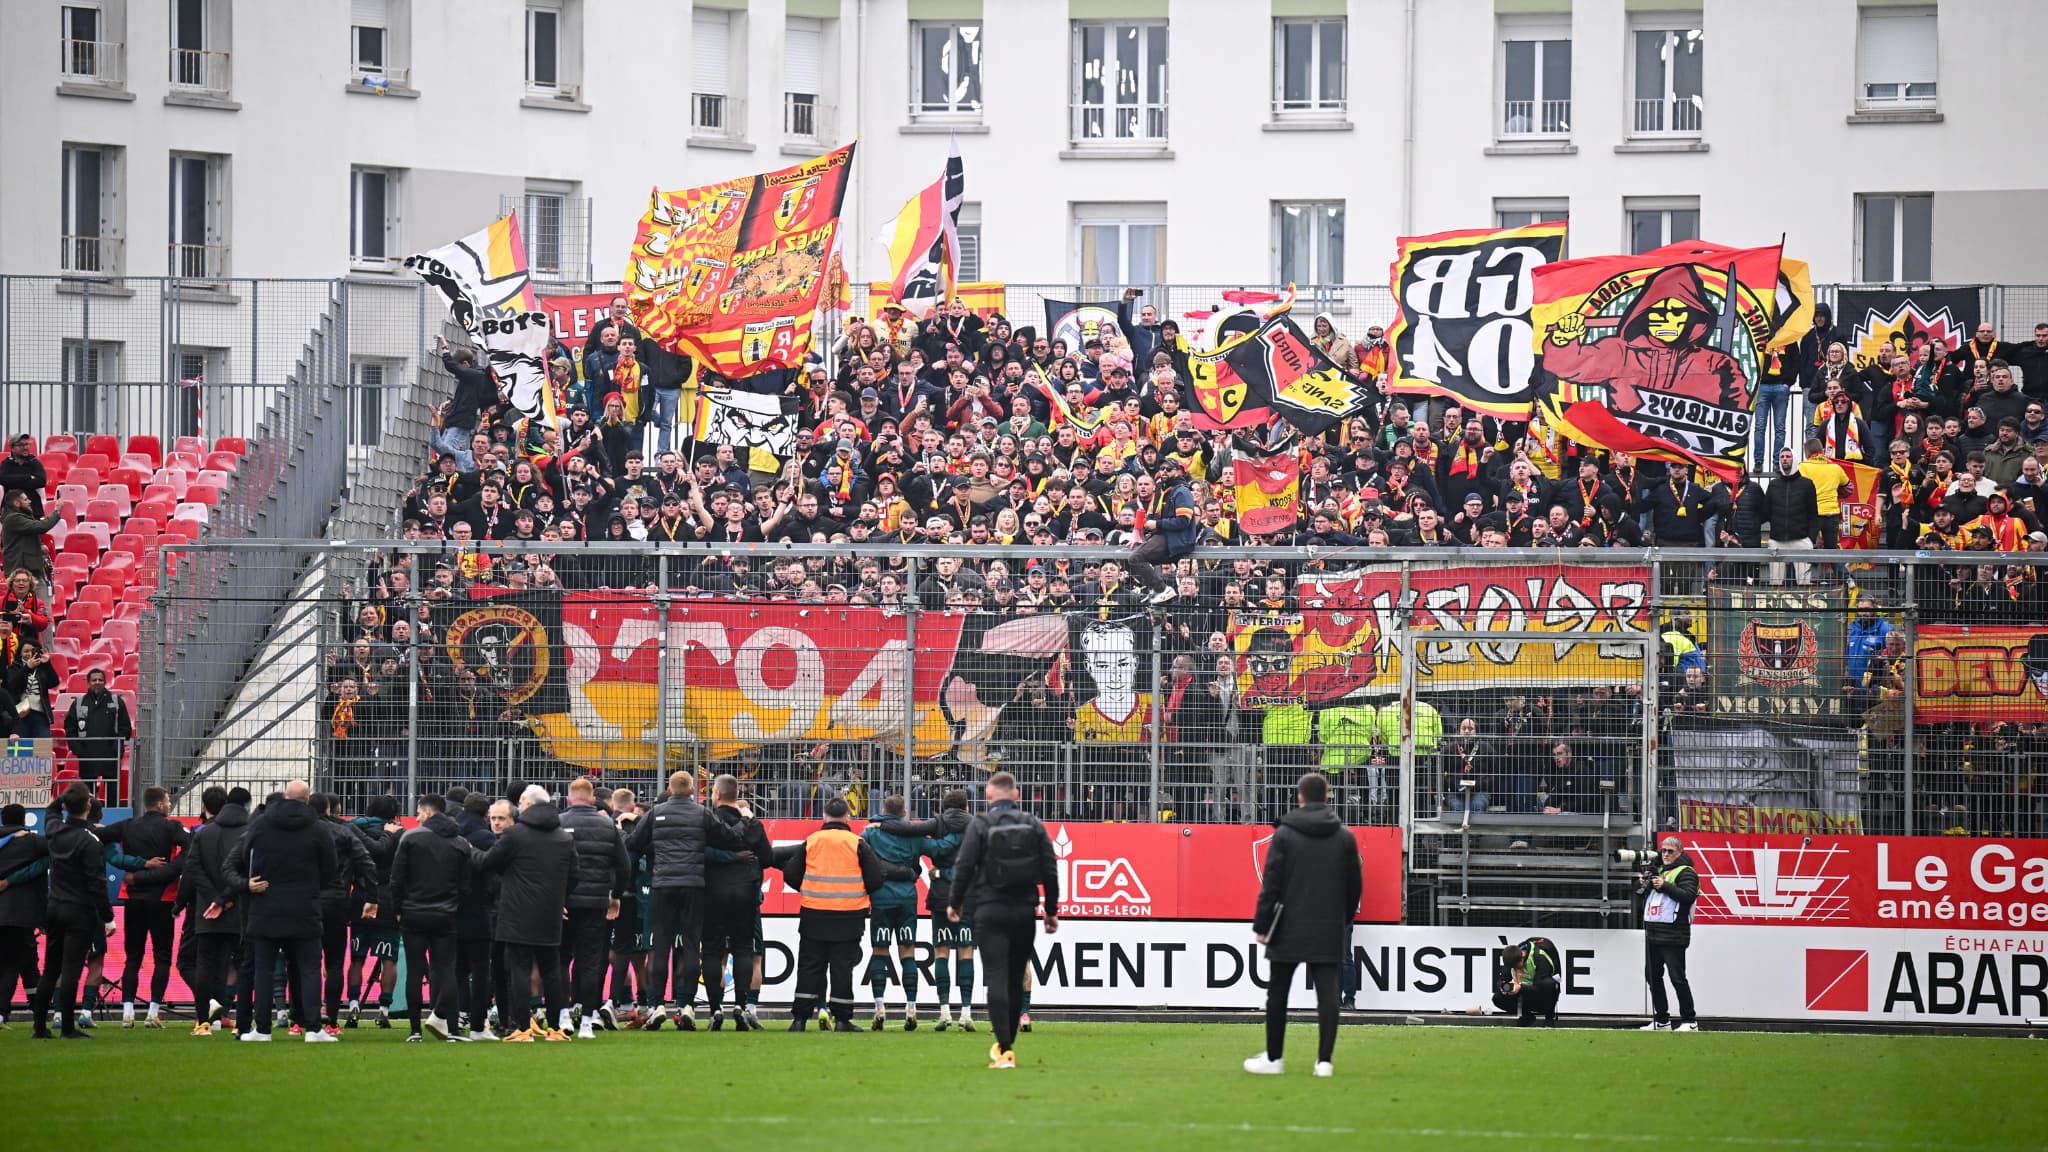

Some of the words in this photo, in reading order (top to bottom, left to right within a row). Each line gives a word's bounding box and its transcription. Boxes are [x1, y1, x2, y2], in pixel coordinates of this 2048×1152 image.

[482, 312, 547, 336] BOYS
[1731, 592, 1828, 612] LENS
[493, 607, 539, 632] TIGERS
[1877, 842, 1948, 892] Le
[1877, 895, 2048, 927] aménage
[1945, 935, 2044, 953] ÉCHAFAU
[1882, 951, 2048, 1017] ABAR
